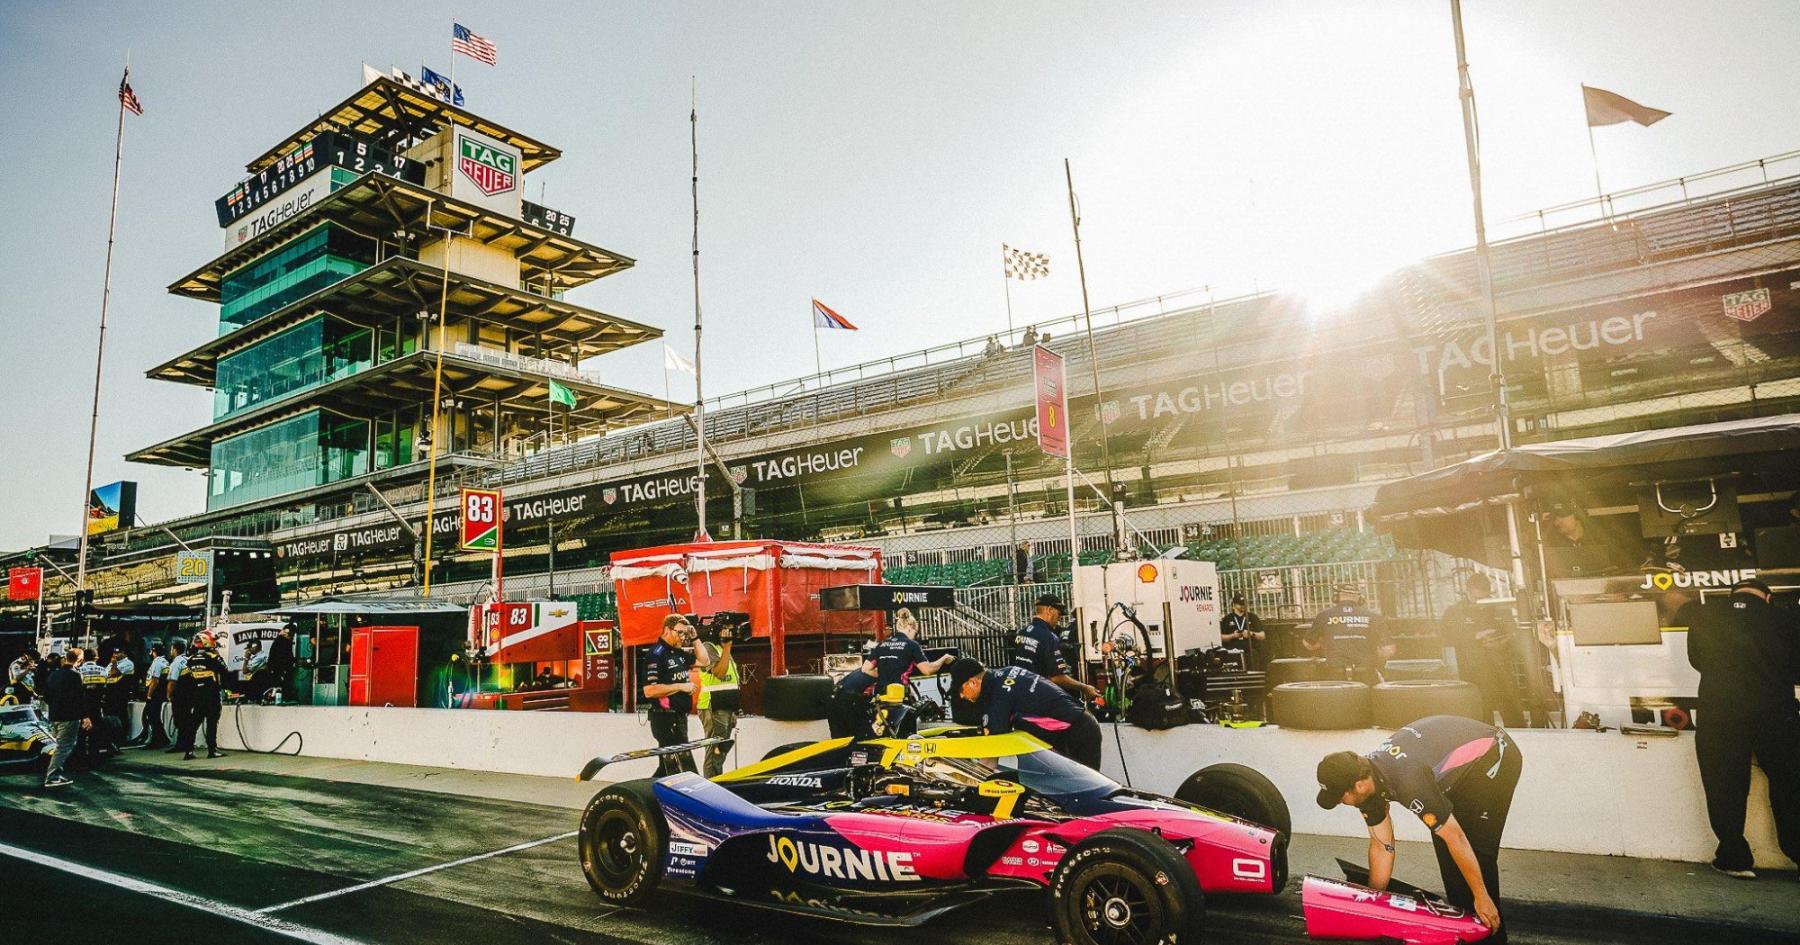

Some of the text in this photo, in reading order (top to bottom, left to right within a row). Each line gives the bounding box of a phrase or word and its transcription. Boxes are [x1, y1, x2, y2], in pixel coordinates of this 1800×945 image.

[337, 151, 344, 165] 1
[354, 157, 365, 171] 2
[356, 142, 406, 169] 5 17
[465, 141, 511, 172] TAG
[463, 160, 513, 191] HEUER
[231, 158, 315, 218] 1 2 3 4 5 6 7 8 9 10
[244, 182, 250, 194] 5
[546, 210, 570, 227] 20 25
[1726, 289, 1766, 305] TAG
[1727, 301, 1768, 318] HEUER
[1049, 404, 1056, 428] 8
[918, 416, 1038, 455] TAGHeue
[467, 495, 494, 523] 83
[181, 557, 207, 577] 20
[1640, 568, 1757, 591] JOURNIE
[892, 591, 928, 604] JOURNIE
[1180, 585, 1213, 603] JOURNIE
[633, 598, 687, 611] PREA
[510, 607, 528, 625] 83
[1327, 615, 1369, 625] JOURNIE
[238, 631, 258, 642] JAVA
[261, 629, 279, 639] HOU
[597, 635, 609, 649] 83
[766, 775, 823, 788] HONDA
[671, 843, 693, 854] JIFFY
[767, 833, 922, 881] JOURNIE
